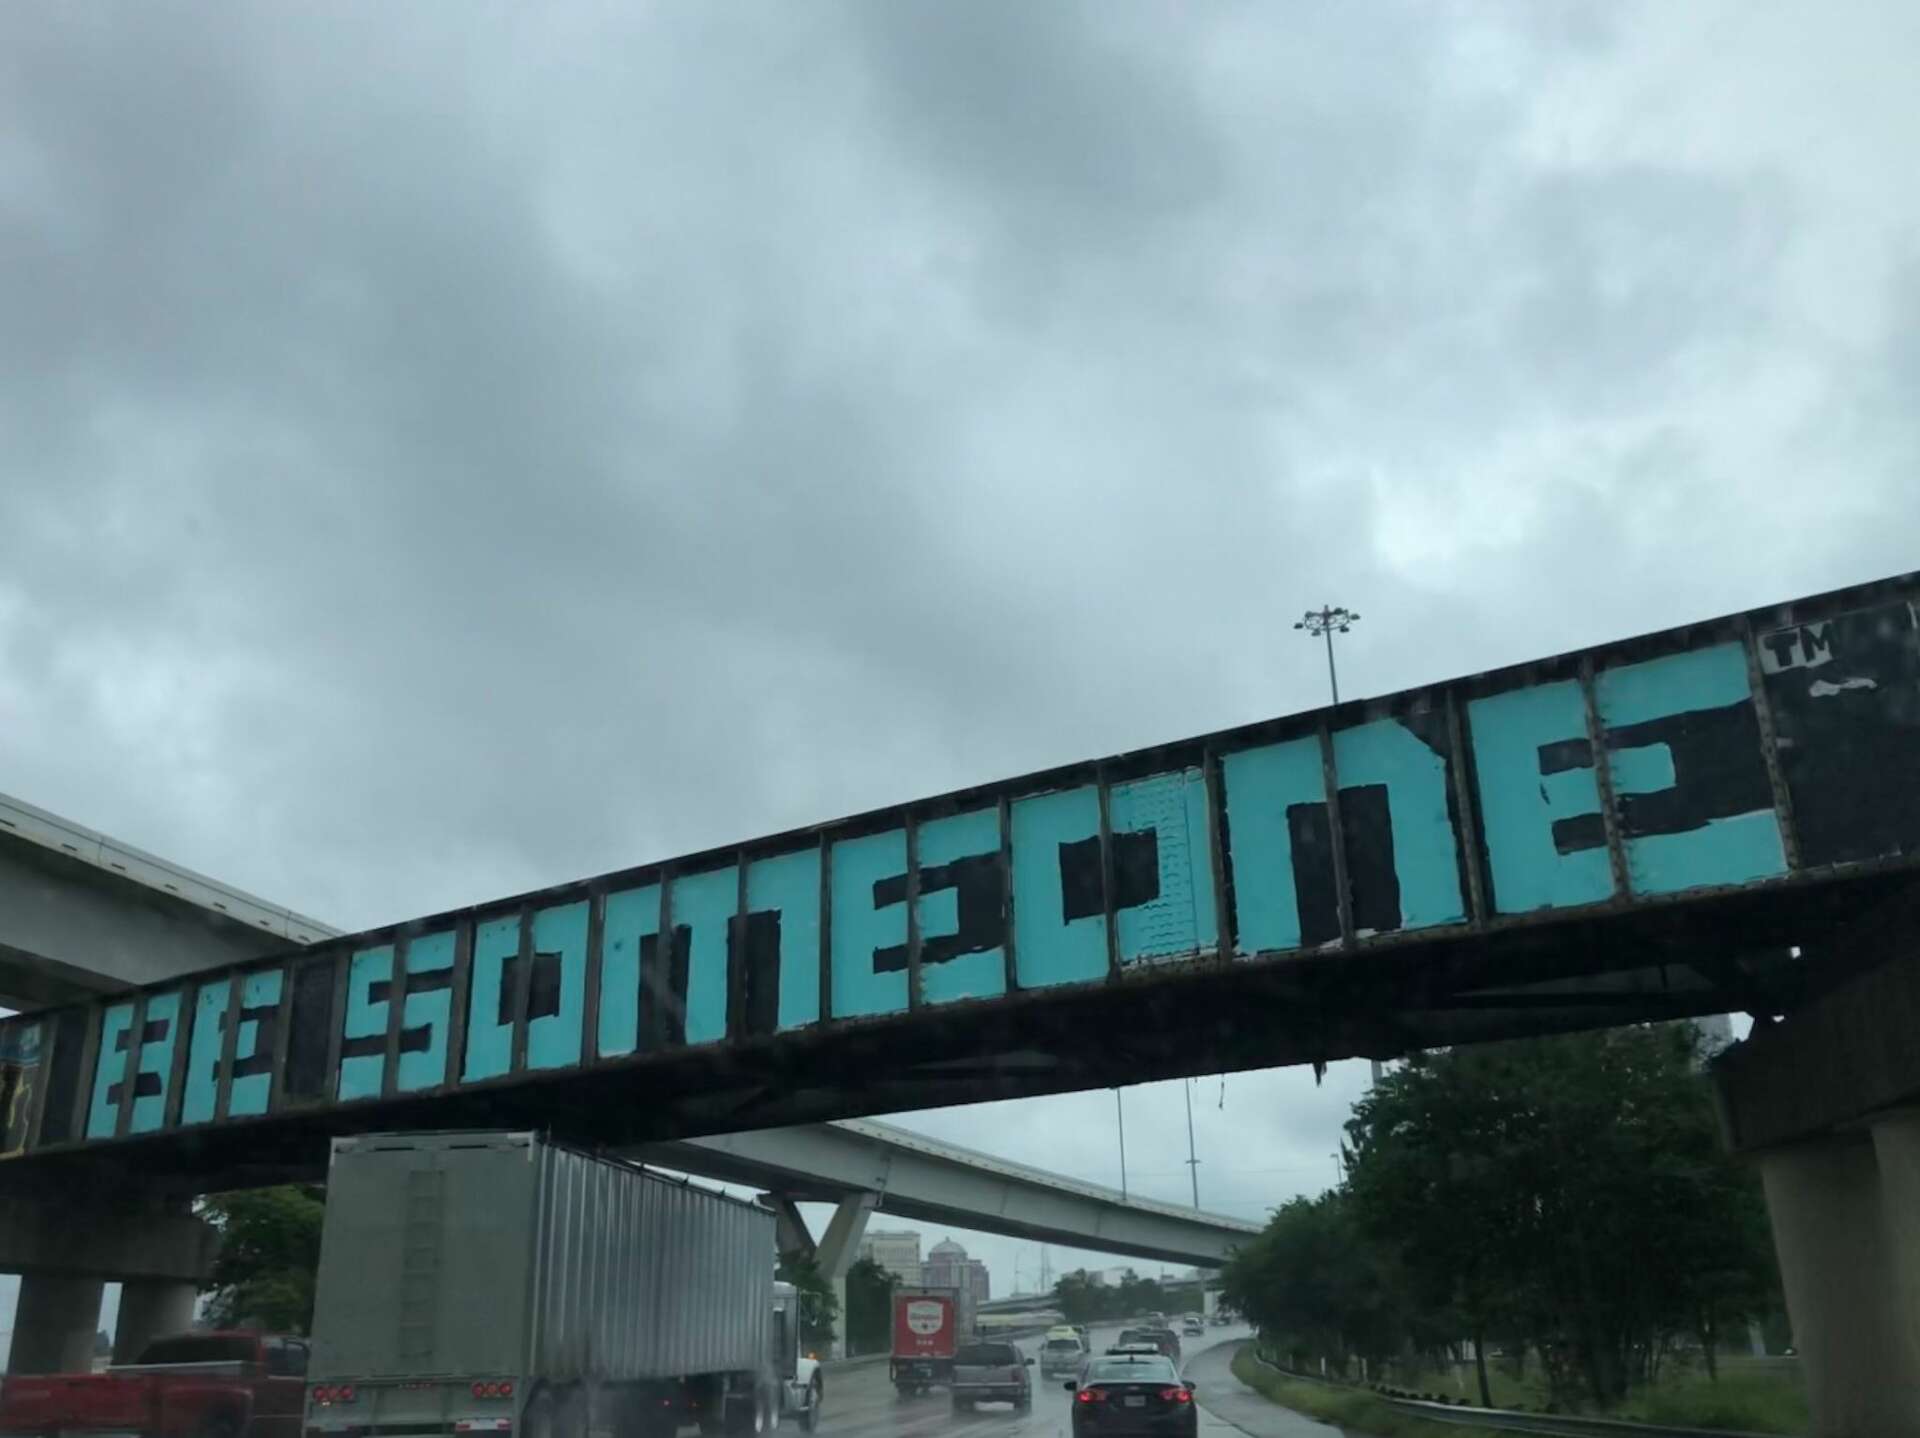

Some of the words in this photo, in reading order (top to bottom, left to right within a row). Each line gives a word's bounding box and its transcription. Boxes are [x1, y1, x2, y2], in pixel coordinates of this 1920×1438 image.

[86, 969, 285, 1139] BE
[338, 639, 1790, 1102] SOMEONE
[1761, 621, 1835, 668] TM
